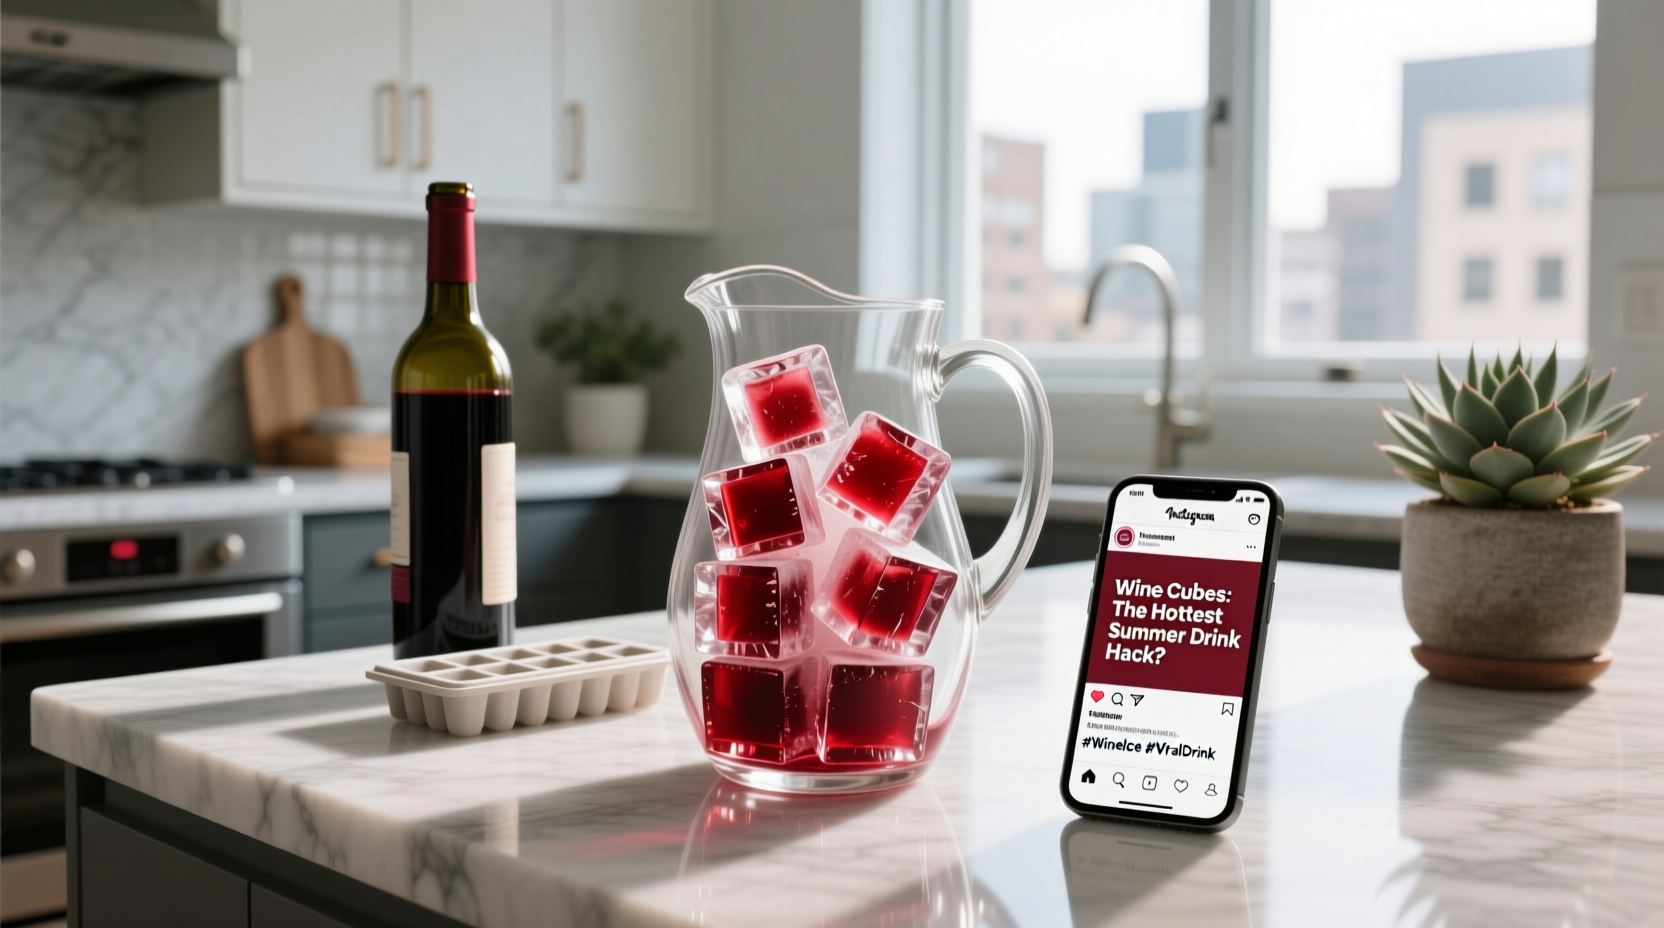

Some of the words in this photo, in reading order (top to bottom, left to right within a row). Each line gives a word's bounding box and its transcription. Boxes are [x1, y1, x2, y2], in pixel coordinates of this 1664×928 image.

[1115, 578, 1164, 598] Wine
[1167, 582, 1232, 603] Cubes:
[1112, 600, 1148, 619] The
[1151, 603, 1224, 625] Hottest
[1108, 622, 1187, 643] Summer
[1190, 627, 1242, 649] Drink
[1105, 642, 1167, 665] Hack?
